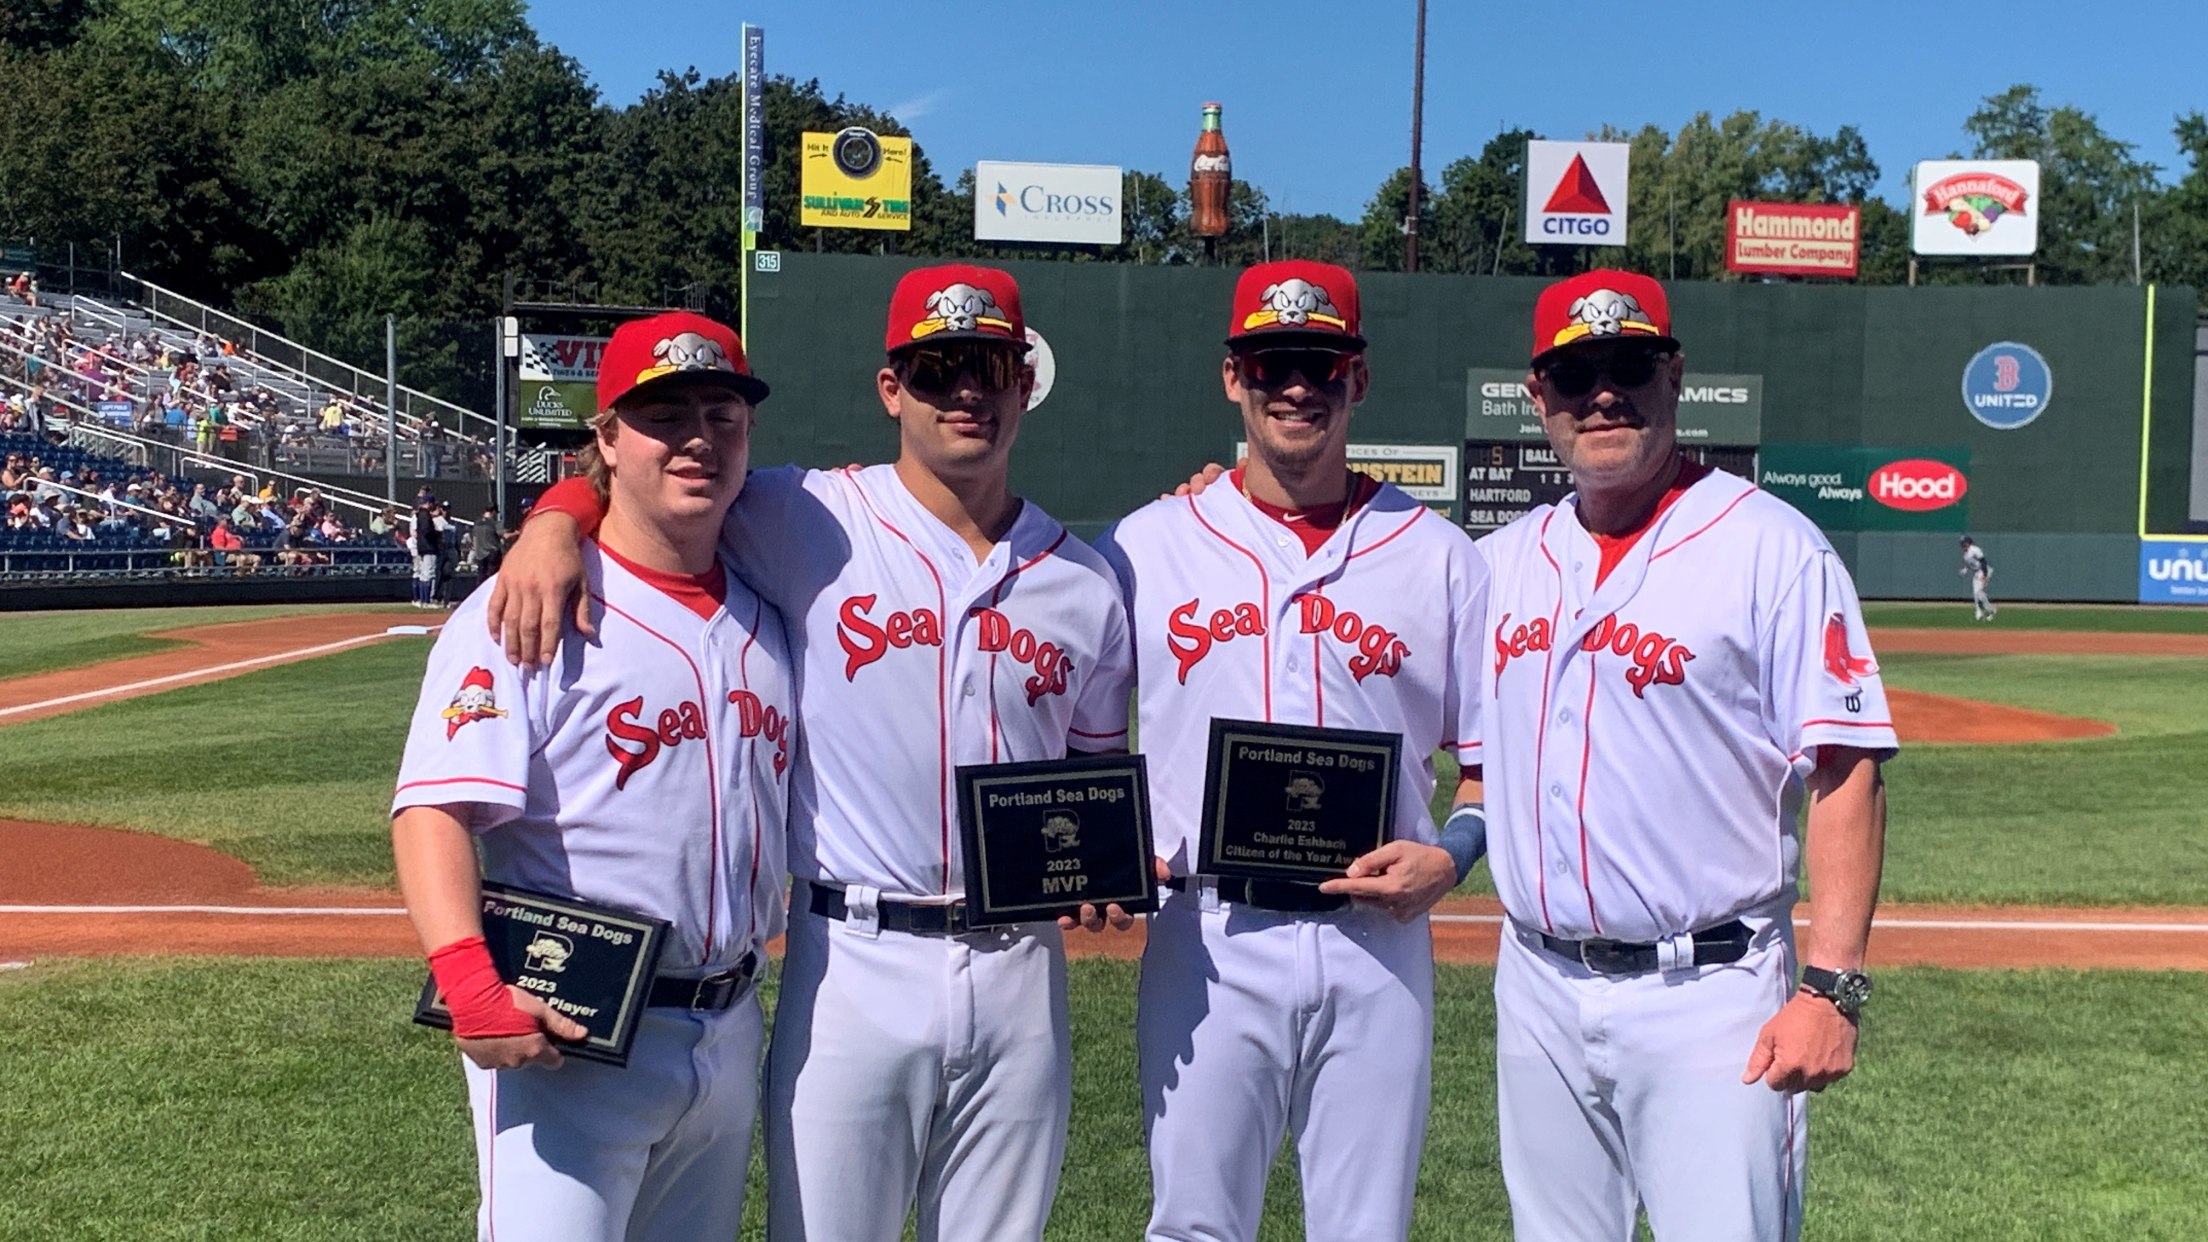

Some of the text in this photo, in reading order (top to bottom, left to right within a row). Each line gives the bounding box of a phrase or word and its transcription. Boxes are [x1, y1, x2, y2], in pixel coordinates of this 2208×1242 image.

[748, 36, 761, 200] Eyecare Medical Group
[1934, 179, 2020, 204] Hannaford
[1543, 217, 1610, 236] CITGO
[1736, 207, 1856, 240] Hammond
[758, 254, 777, 269] 315
[1790, 244, 1852, 264] Company
[1482, 400, 1517, 416] Bath
[1974, 394, 2038, 408] UNITED
[1346, 462, 1442, 484] STEIN
[1468, 466, 1514, 481] AT BAT
[1554, 474, 1561, 484] 2
[1763, 472, 1806, 488] Always
[1469, 488, 1532, 502] HARTFORD
[1818, 486, 1863, 502] Always
[1880, 472, 1956, 499] Hood
[1470, 510, 1494, 524] SEA
[1167, 592, 1412, 686] Sea Dogs
[837, 593, 1076, 708] Sea Dogs
[605, 695, 706, 791] Sea
[1238, 746, 1376, 772] Portland Sea Dogs
[988, 786, 1126, 808] Portland Sea Dogs
[1288, 818, 1316, 832] 2023
[1254, 831, 1346, 850] Charlie Eshbach
[1225, 844, 1266, 858] Citizen
[1268, 848, 1280, 859] of
[1283, 850, 1302, 862] the
[1306, 851, 1332, 864] Year
[1046, 858, 1082, 872] 2023
[1042, 874, 1089, 894] MVP
[484, 900, 633, 946] Portland Sea Dogs
[516, 975, 557, 993] 2023
[548, 997, 599, 1018] Player
